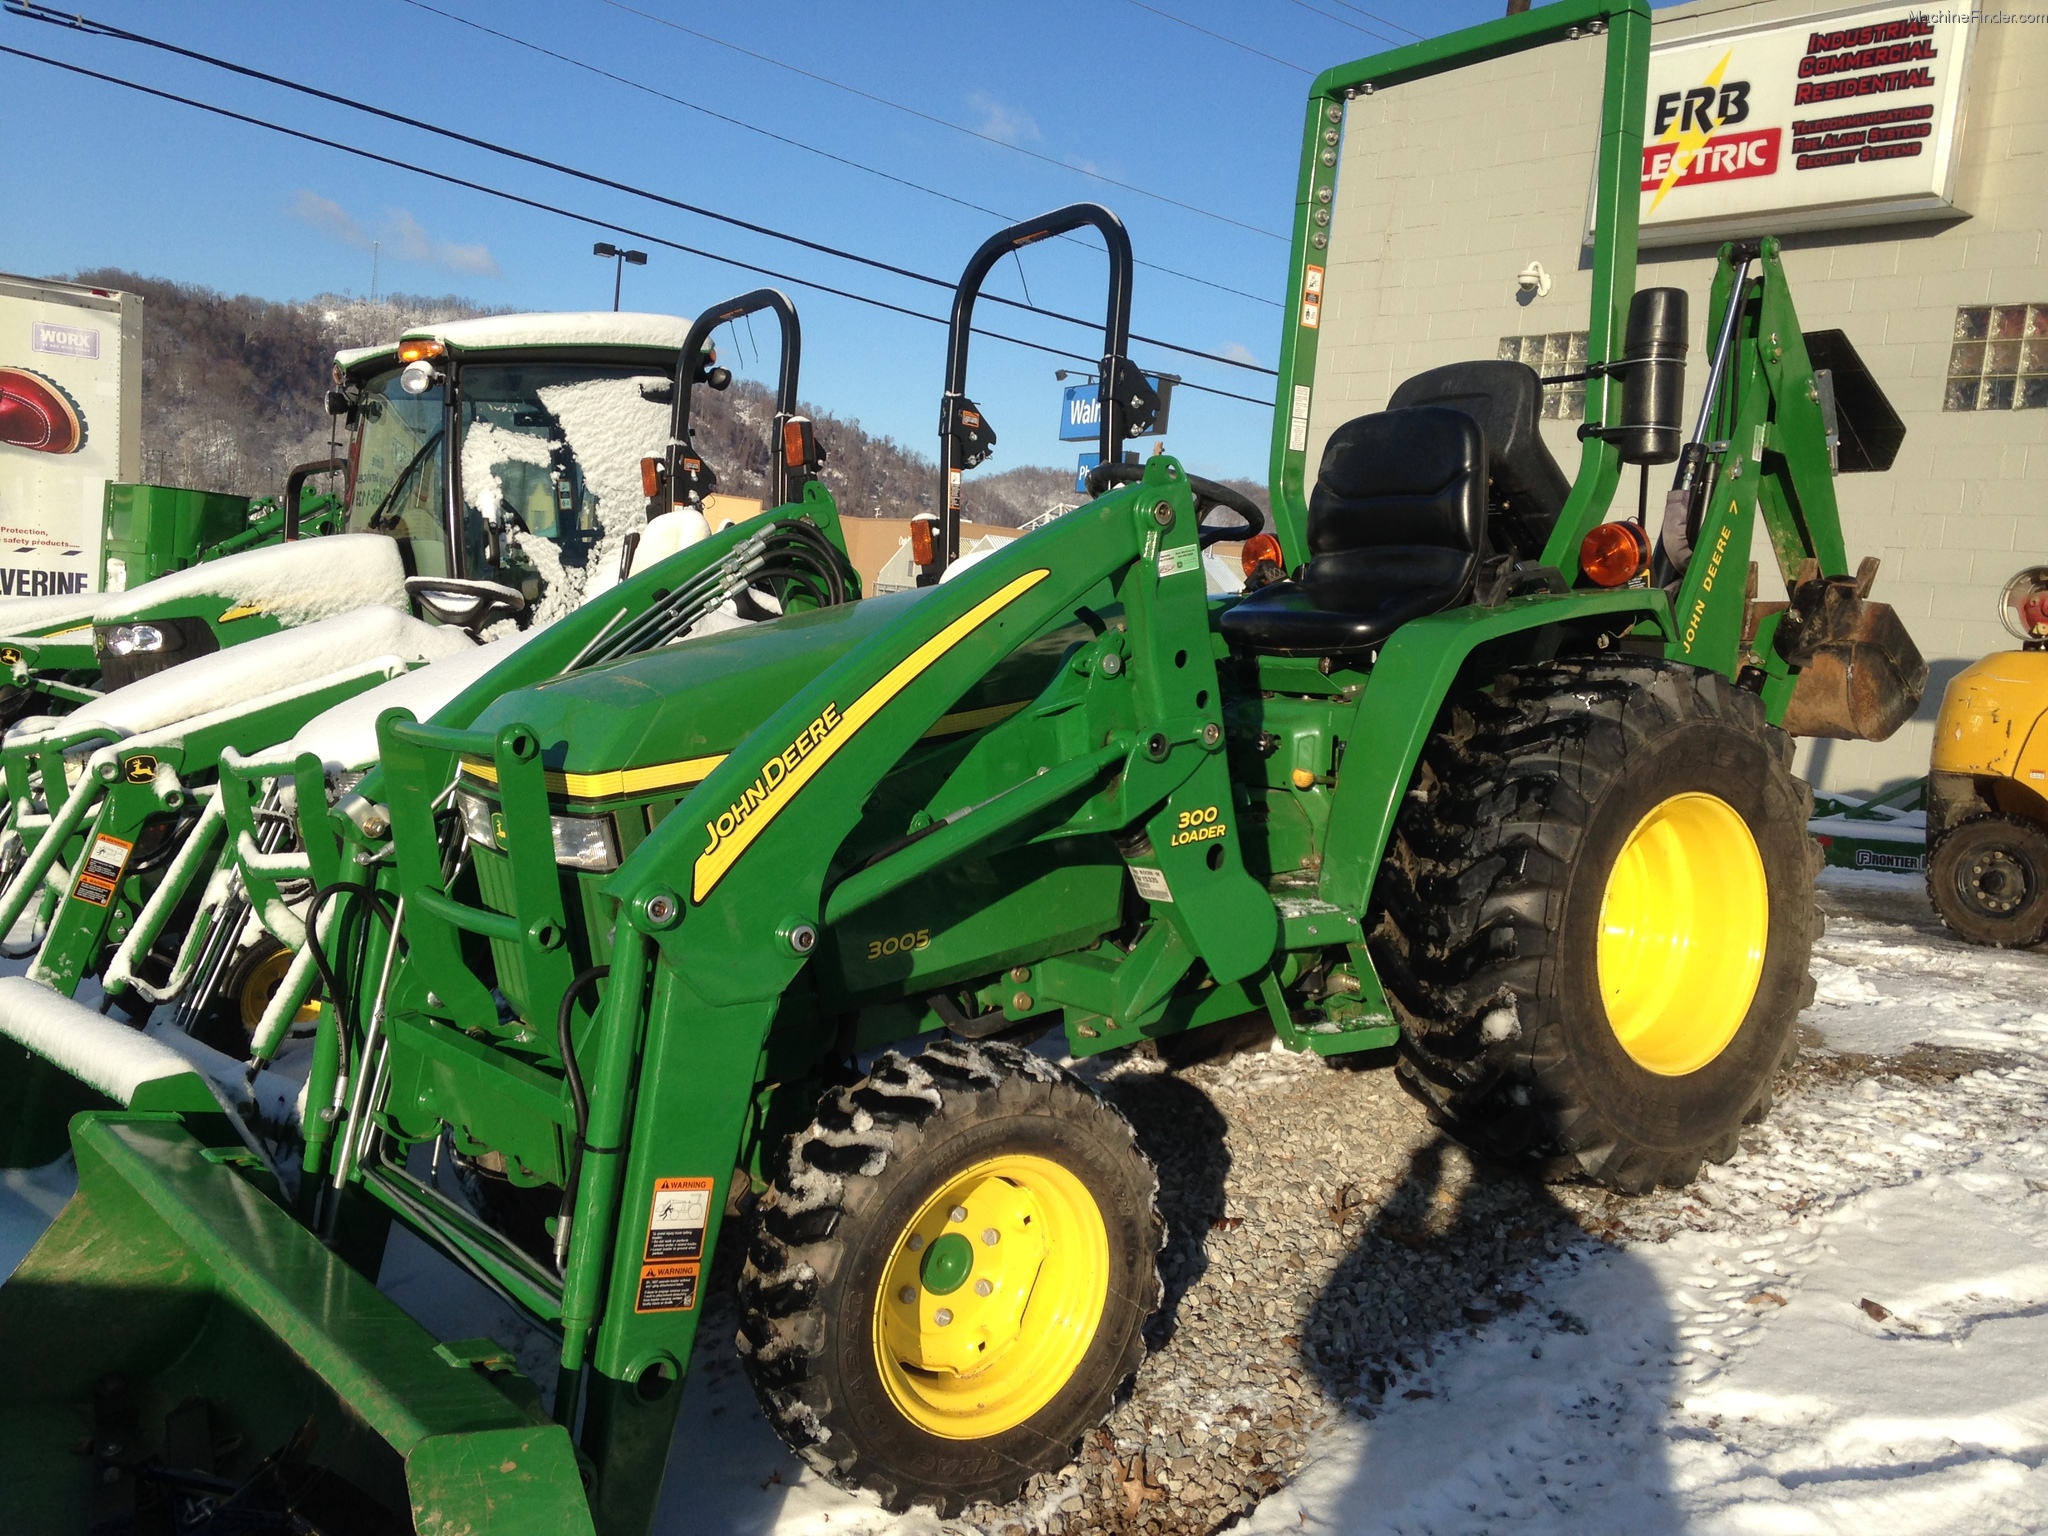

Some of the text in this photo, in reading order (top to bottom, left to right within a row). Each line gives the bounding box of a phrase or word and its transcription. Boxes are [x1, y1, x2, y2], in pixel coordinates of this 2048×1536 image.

[1807, 20, 1934, 54] INDUSTRIAL
[1798, 39, 1938, 79] COMMERCIAL
[1794, 67, 1935, 106] RESIDENTIAL
[1654, 81, 1751, 136] ERB
[1792, 104, 1934, 136] TELECOMMUNICATIONS
[1792, 122, 1932, 154] FIRE ALARM SYSTEMS
[1641, 139, 1768, 182] LECTRIC
[1796, 141, 1922, 171] SECURITY SYSTEMS
[40, 329, 90, 348] WORX
[0, 526, 48, 537] Protection,
[3, 537, 30, 546] safety
[0, 567, 88, 597] VERINE
[1683, 600, 1706, 654] JOHN
[1703, 525, 1732, 592] DEERE
[704, 701, 843, 857] JOHN DEERE
[1177, 806, 1218, 830] 300
[1171, 824, 1226, 848] LOADER
[1857, 850, 1918, 869] FRONTIER
[867, 928, 930, 960] 3005
[671, 1181, 707, 1189] WARNING
[657, 1267, 693, 1276] WARNING
